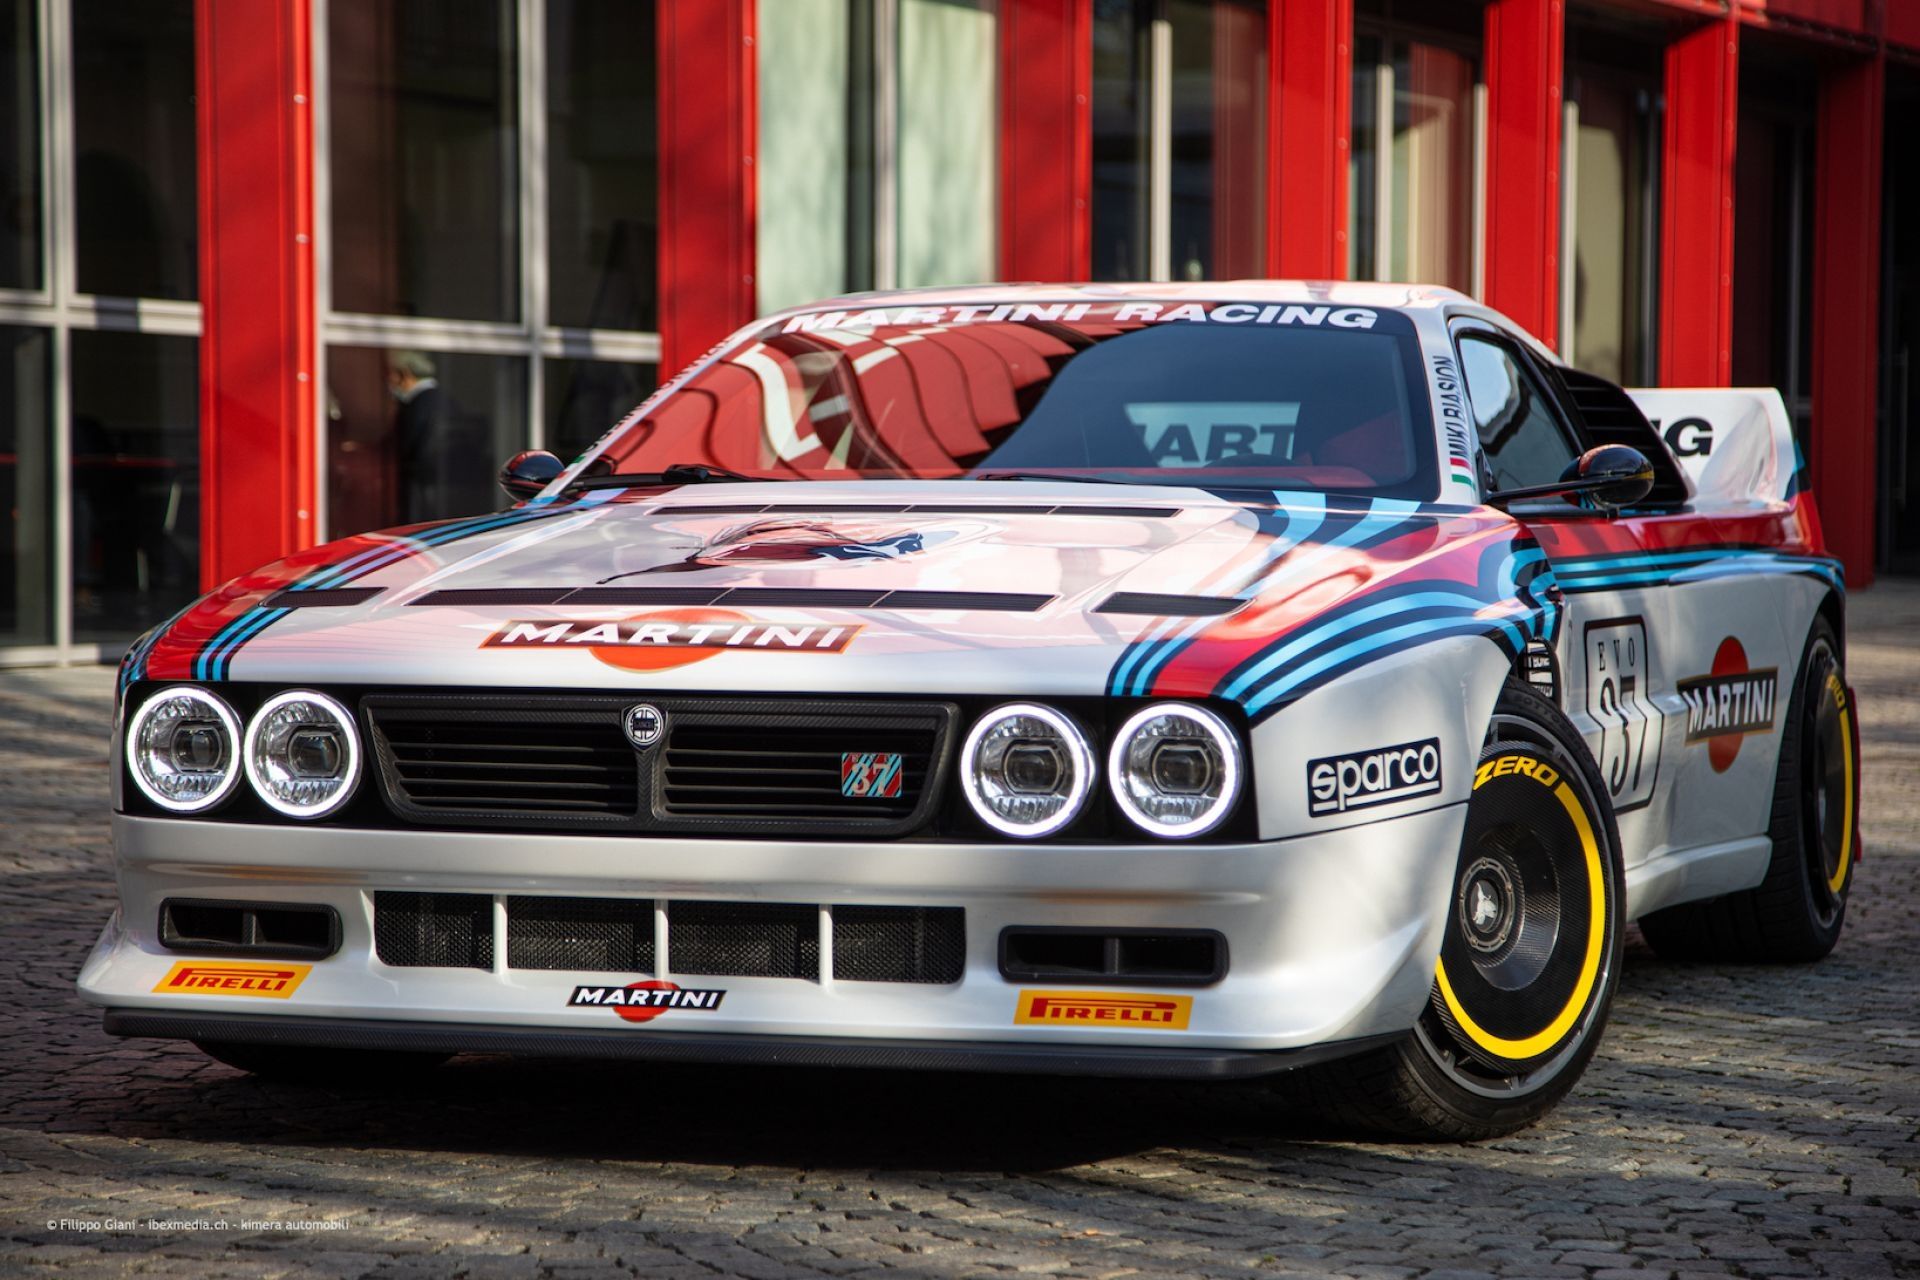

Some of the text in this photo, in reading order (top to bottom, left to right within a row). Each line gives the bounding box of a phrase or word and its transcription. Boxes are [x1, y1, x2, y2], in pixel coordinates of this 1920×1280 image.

[781, 303, 1379, 333] MARTINI RACING
[1432, 355, 1469, 458] MIKI BIASION
[1137, 423, 1298, 462] ART
[500, 622, 846, 648] MARTINI
[1682, 679, 1775, 734] MARTINI
[851, 762, 890, 796] 37
[1311, 744, 1439, 811] sparco
[1472, 755, 1560, 790] ZERO
[168, 967, 296, 992] PIRELLI
[575, 987, 719, 1008] MARTINI
[1029, 997, 1178, 1023] PIRELLI
